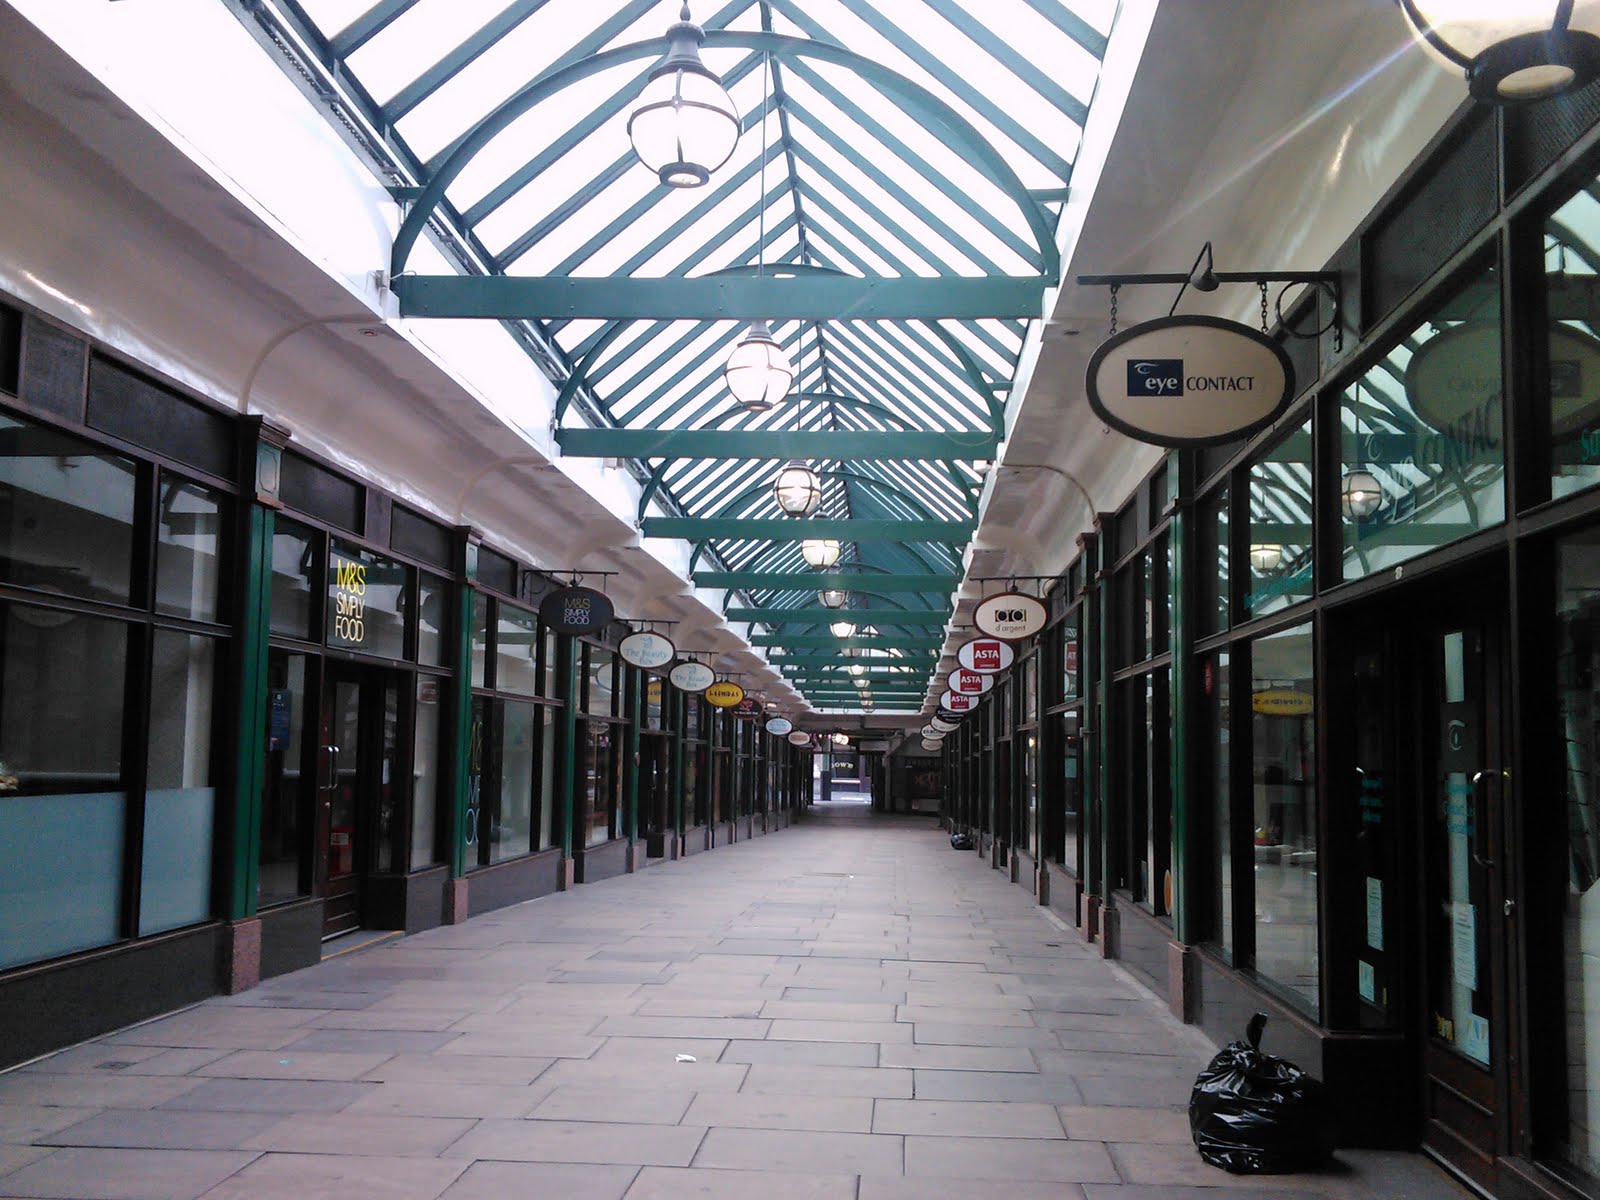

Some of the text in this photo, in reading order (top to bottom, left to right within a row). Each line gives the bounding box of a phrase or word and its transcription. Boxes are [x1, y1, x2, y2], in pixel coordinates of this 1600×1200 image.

[1145, 377, 1255, 394] eye CONTACT
[337, 558, 366, 596] M&S
[336, 591, 365, 619] SIMPLY
[564, 597, 591, 609] M&S
[564, 608, 591, 617] SIMPLY
[563, 615, 590, 625] FOOD
[335, 616, 364, 642] FOOD
[974, 649, 999, 659] ASTA
[960, 675, 981, 684] ASTA
[951, 695, 969, 703] ASTA
